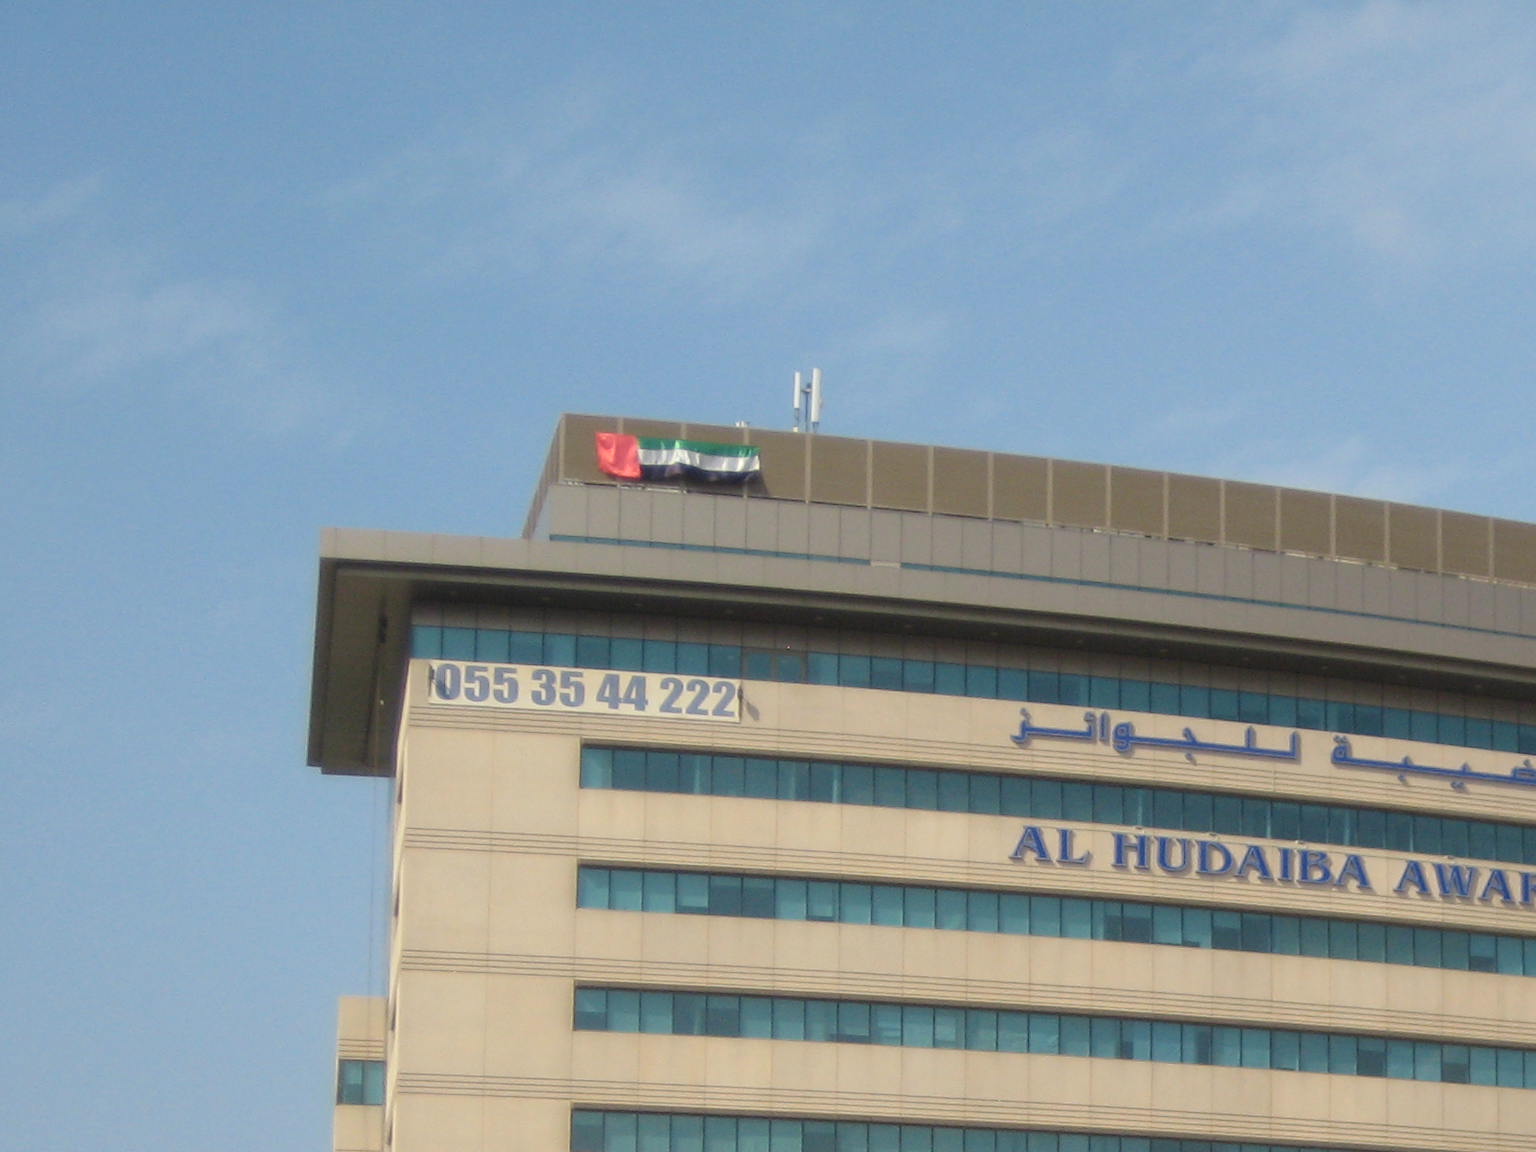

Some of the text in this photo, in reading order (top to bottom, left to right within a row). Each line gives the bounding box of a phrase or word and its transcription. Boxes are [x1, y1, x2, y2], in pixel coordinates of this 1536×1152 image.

[434, 663, 737, 718] 055 35 44 222
[1011, 708, 1301, 763] للجوائز
[1010, 825, 1090, 864] AL
[1112, 832, 1372, 890] HUDAIBA
